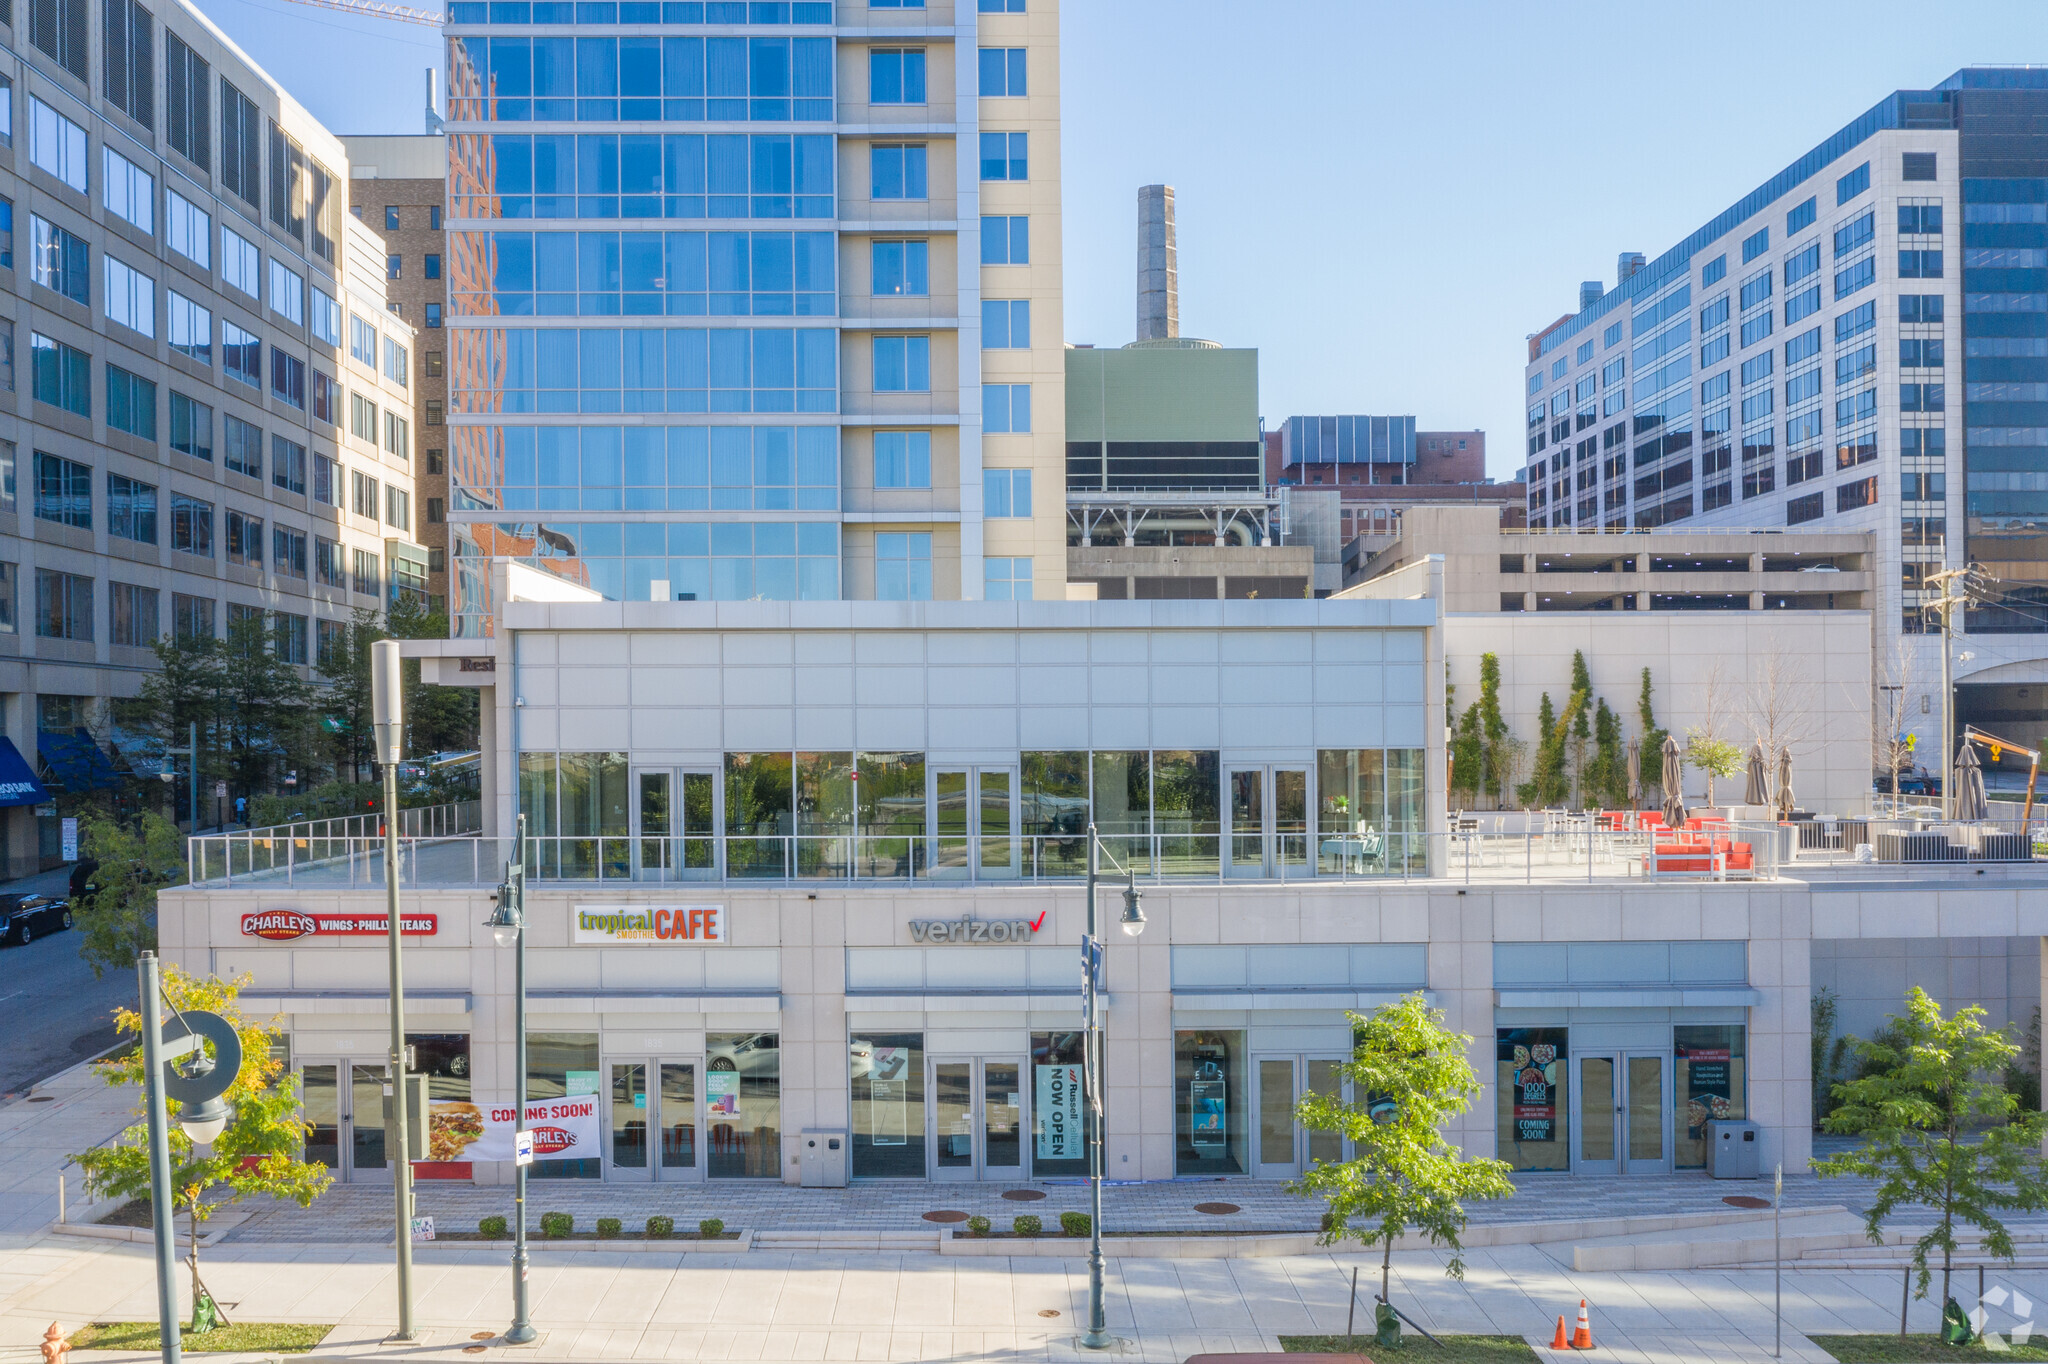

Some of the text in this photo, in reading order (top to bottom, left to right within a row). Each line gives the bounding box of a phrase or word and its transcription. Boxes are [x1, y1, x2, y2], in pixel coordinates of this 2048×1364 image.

[243, 915, 315, 934] CHARLEYS
[319, 919, 354, 931] WINGS
[400, 919, 432, 931] TEAKS
[578, 909, 718, 940] tropical CAFE
[908, 914, 1031, 943] verizon
[616, 929, 655, 940] SMOOTHIE
[1051, 1068, 1063, 1106] NOW
[1524, 1082, 1546, 1092] 1000
[1523, 1092, 1546, 1100] DEGREES
[551, 1103, 593, 1119] SOON!
[1519, 1120, 1549, 1130] COMING
[533, 1131, 578, 1146] ARLEYS
[1052, 1111, 1064, 1155] OPEN
[1523, 1129, 1547, 1140] SOON!
